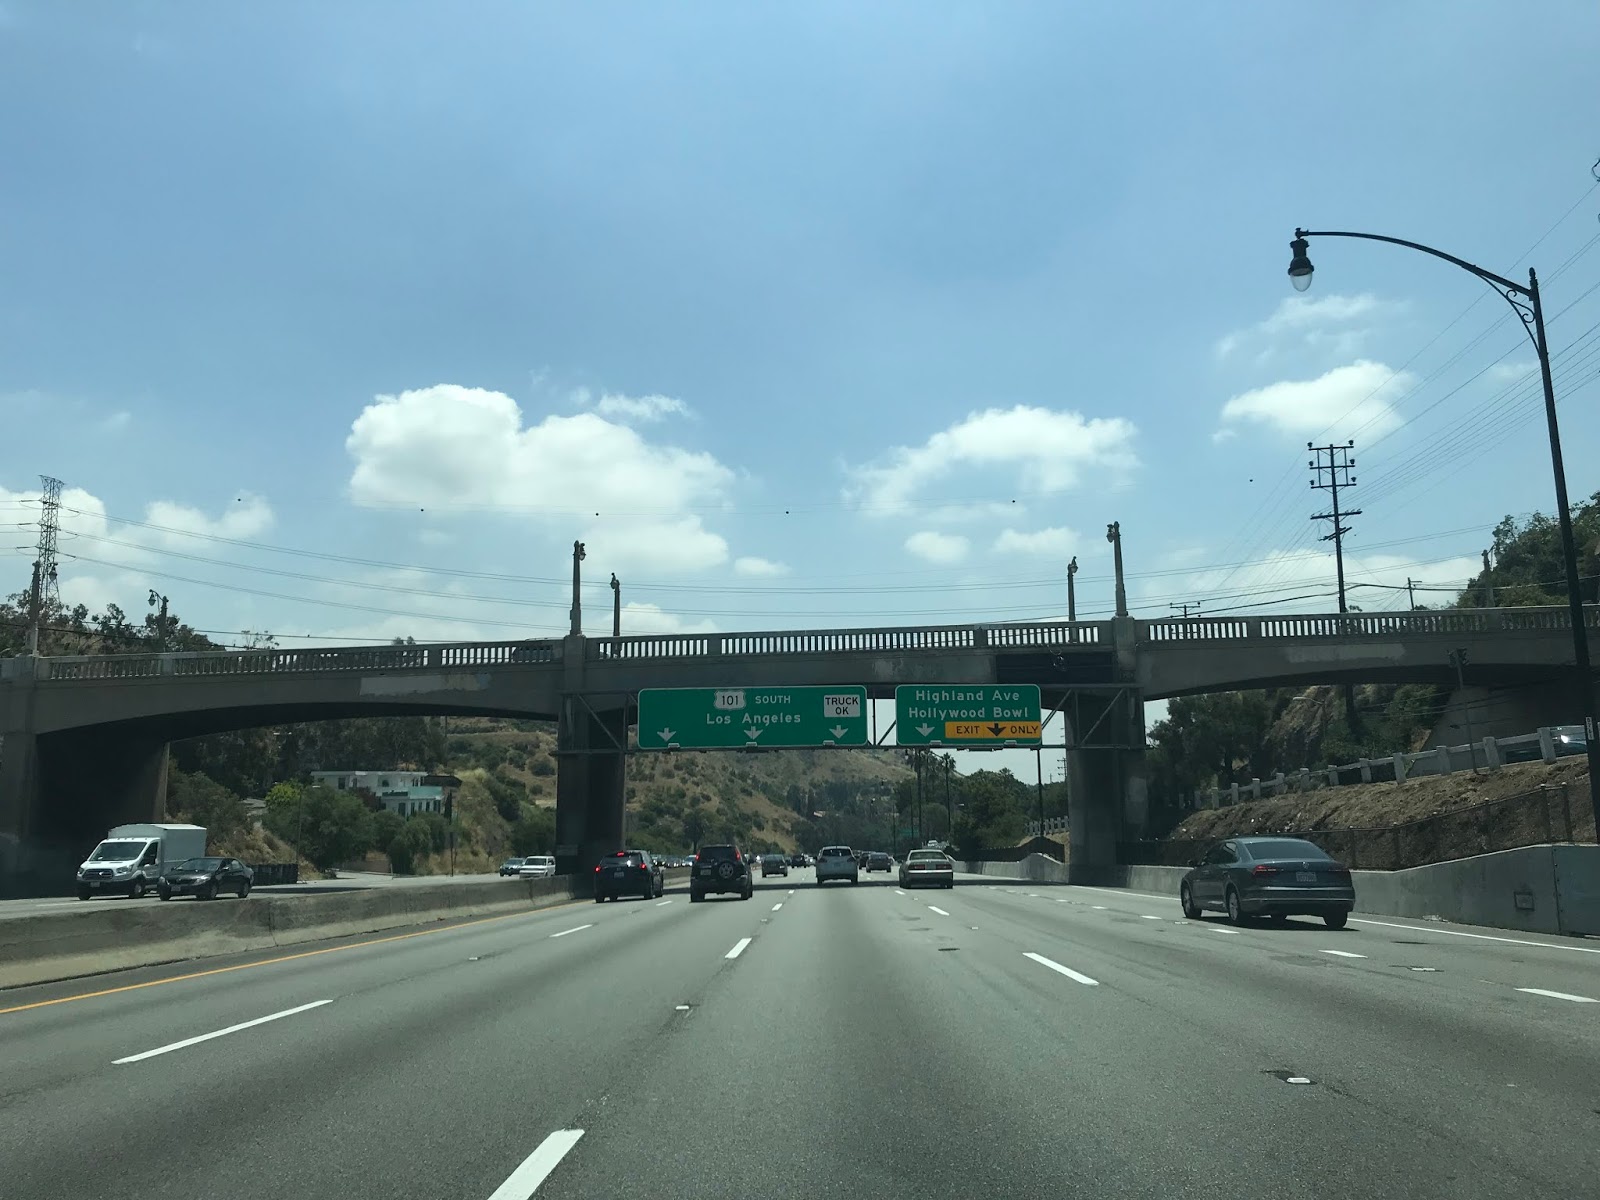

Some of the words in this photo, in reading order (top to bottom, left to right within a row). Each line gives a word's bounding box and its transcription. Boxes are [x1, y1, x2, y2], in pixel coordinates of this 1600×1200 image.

[721, 695, 739, 706] 101
[755, 695, 791, 704] SOUTH
[825, 696, 859, 706] TRUCK
[916, 690, 984, 704] Highland
[992, 690, 1020, 701] Ave
[835, 706, 849, 715] OK
[908, 707, 985, 720] Hollywood
[993, 707, 1029, 718] Bowl
[706, 713, 731, 724] Los
[742, 713, 801, 726] Angeles
[956, 725, 980, 734] EXIT
[1010, 725, 1039, 734] ONLY
